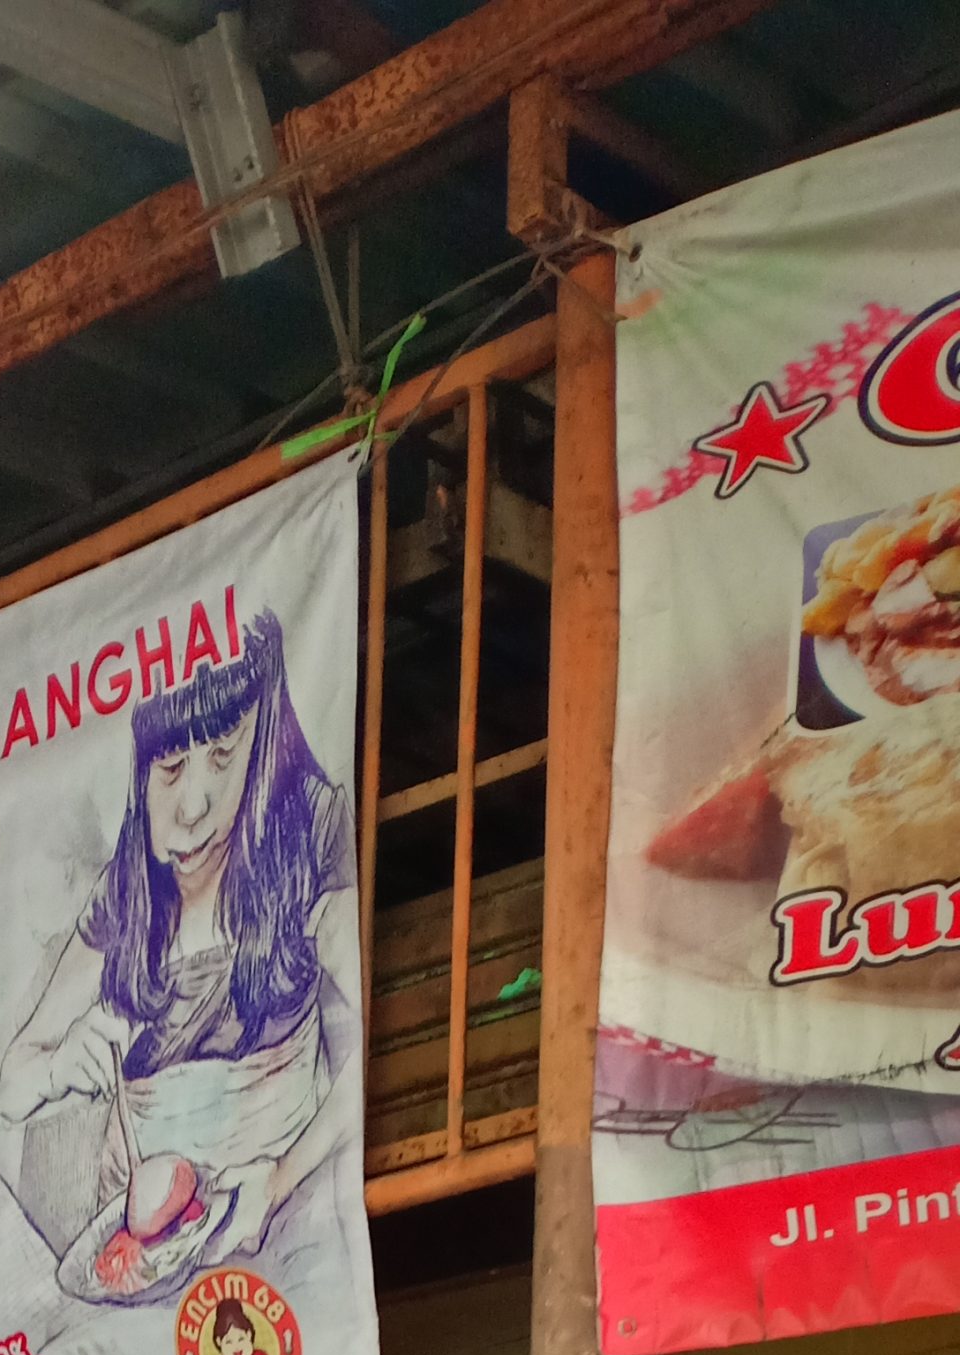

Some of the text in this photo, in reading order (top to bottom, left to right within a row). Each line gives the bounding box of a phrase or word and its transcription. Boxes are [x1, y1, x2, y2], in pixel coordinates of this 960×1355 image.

[772, 880, 960, 986] Lu
[770, 1203, 835, 1247] Jl.
[180, 1273, 286, 1343] ENCIM 68
